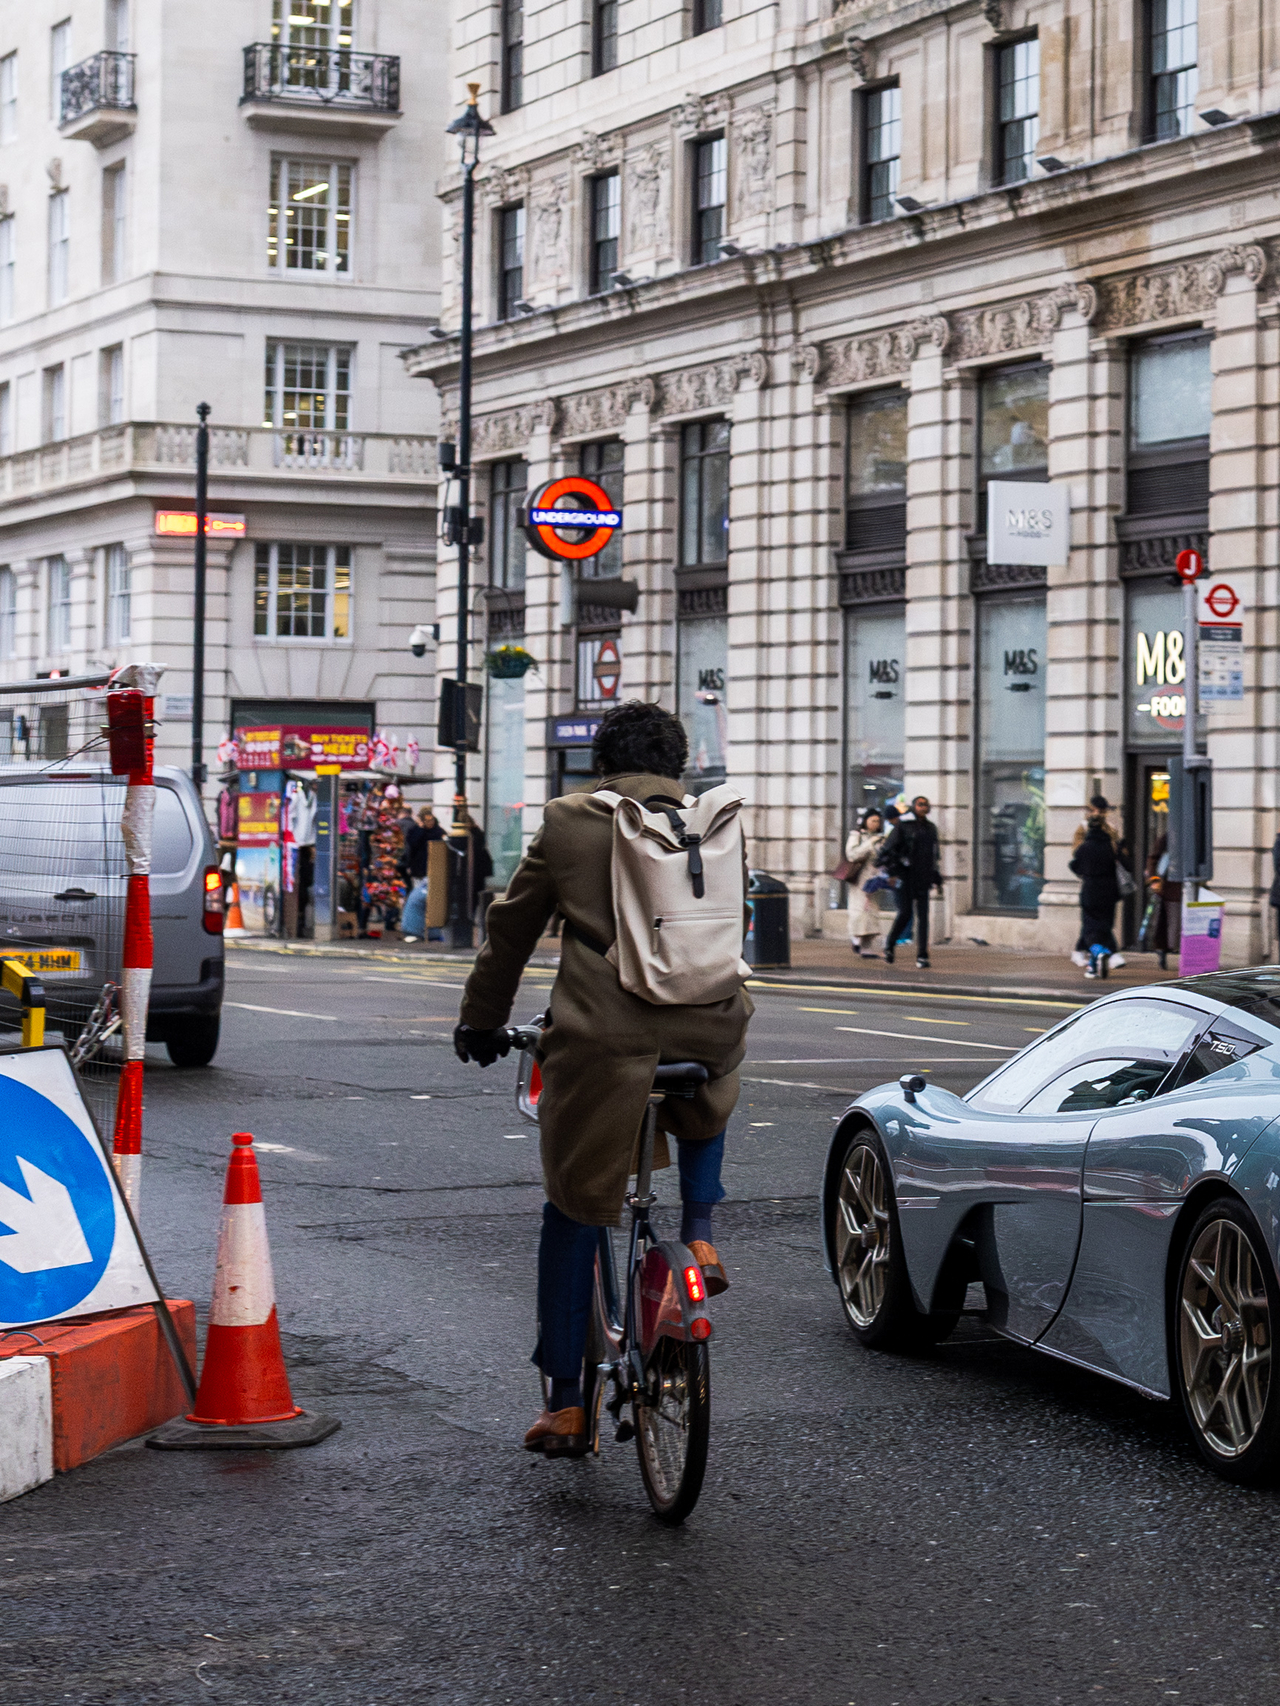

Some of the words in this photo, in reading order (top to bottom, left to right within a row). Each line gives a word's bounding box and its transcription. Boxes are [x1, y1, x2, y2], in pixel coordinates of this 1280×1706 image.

[532, 511, 620, 525] UNDERGROUND
[1006, 508, 1053, 531] M&S
[1183, 553, 1197, 575] J
[1004, 648, 1038, 676] M&S
[1137, 630, 1186, 686] M&
[1151, 695, 1186, 718] FOO
